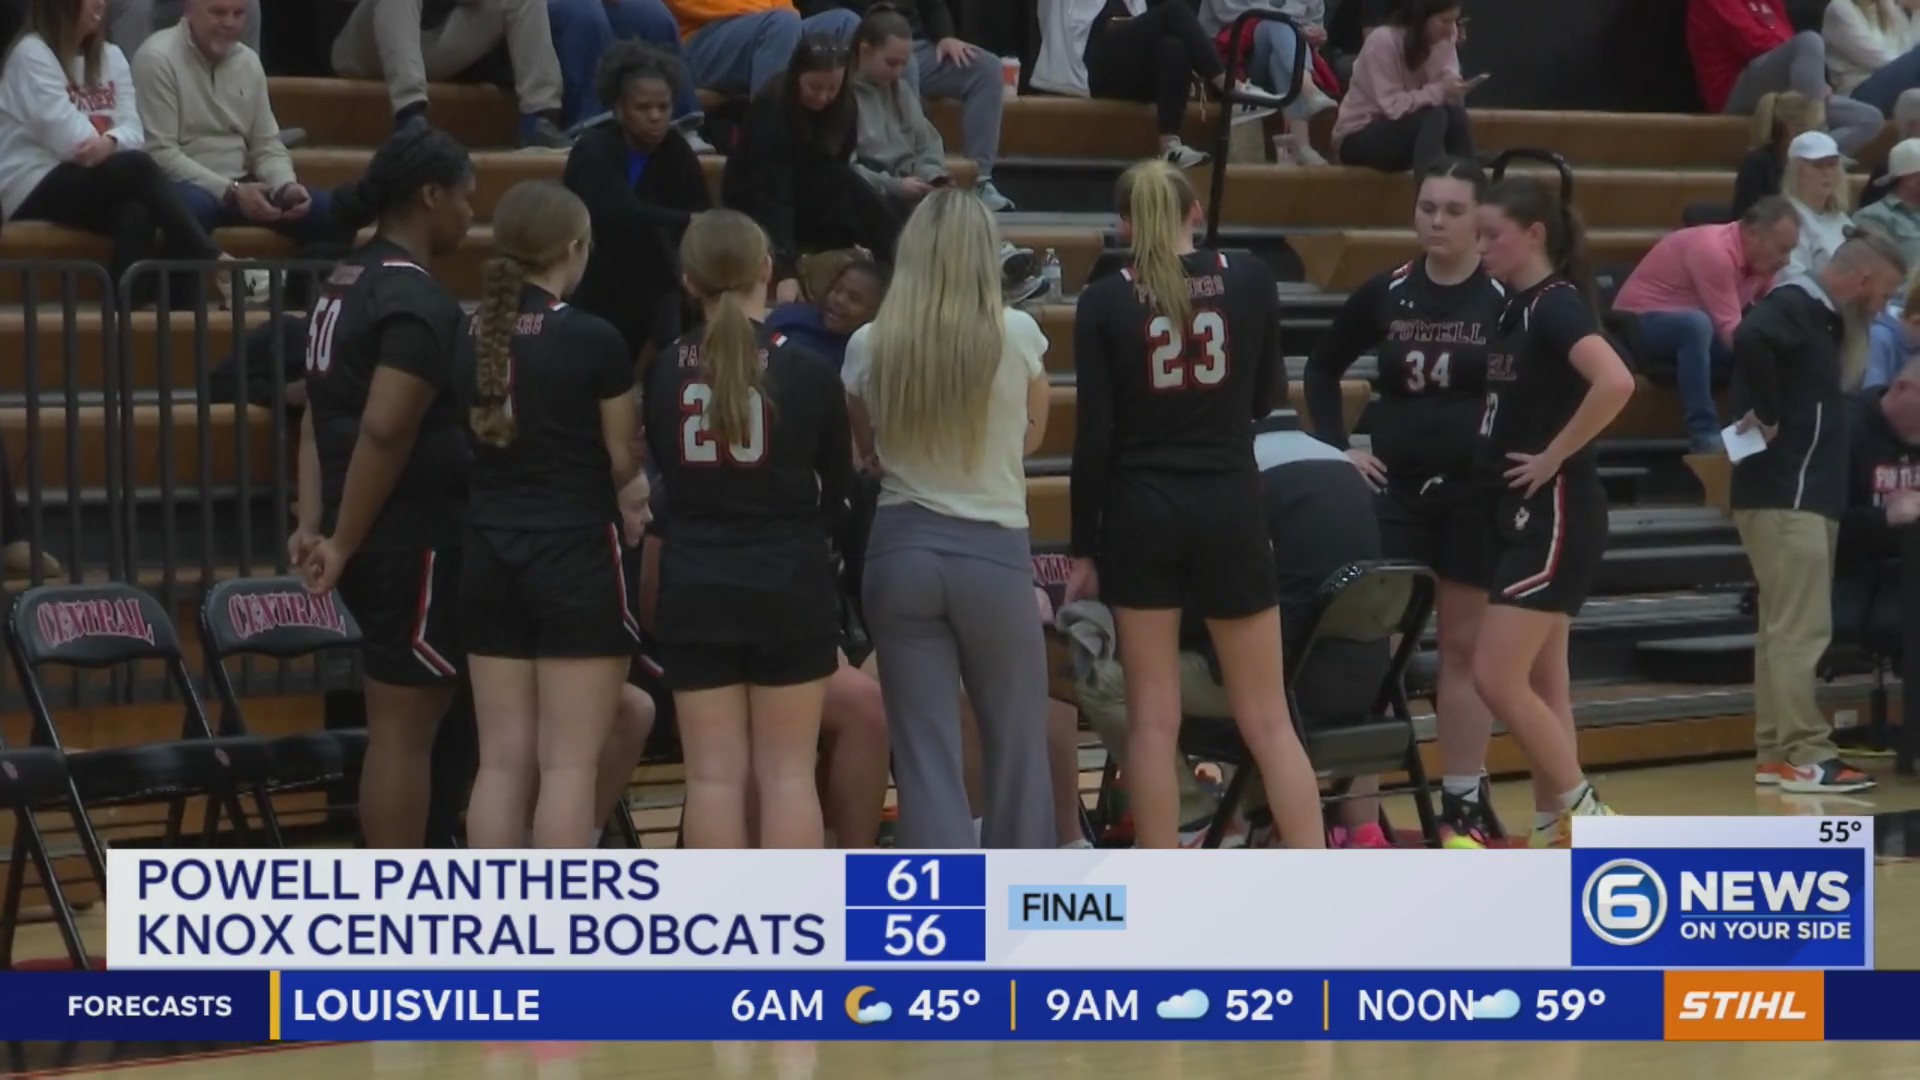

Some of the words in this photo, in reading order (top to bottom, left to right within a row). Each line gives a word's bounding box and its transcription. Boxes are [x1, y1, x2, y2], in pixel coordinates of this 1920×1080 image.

[304, 295, 343, 372] 50
[1148, 310, 1227, 389] 23
[1405, 350, 1450, 391] 34
[682, 382, 765, 463] 20
[37, 597, 155, 650] CENTRAL
[227, 591, 347, 639] CENTRAL
